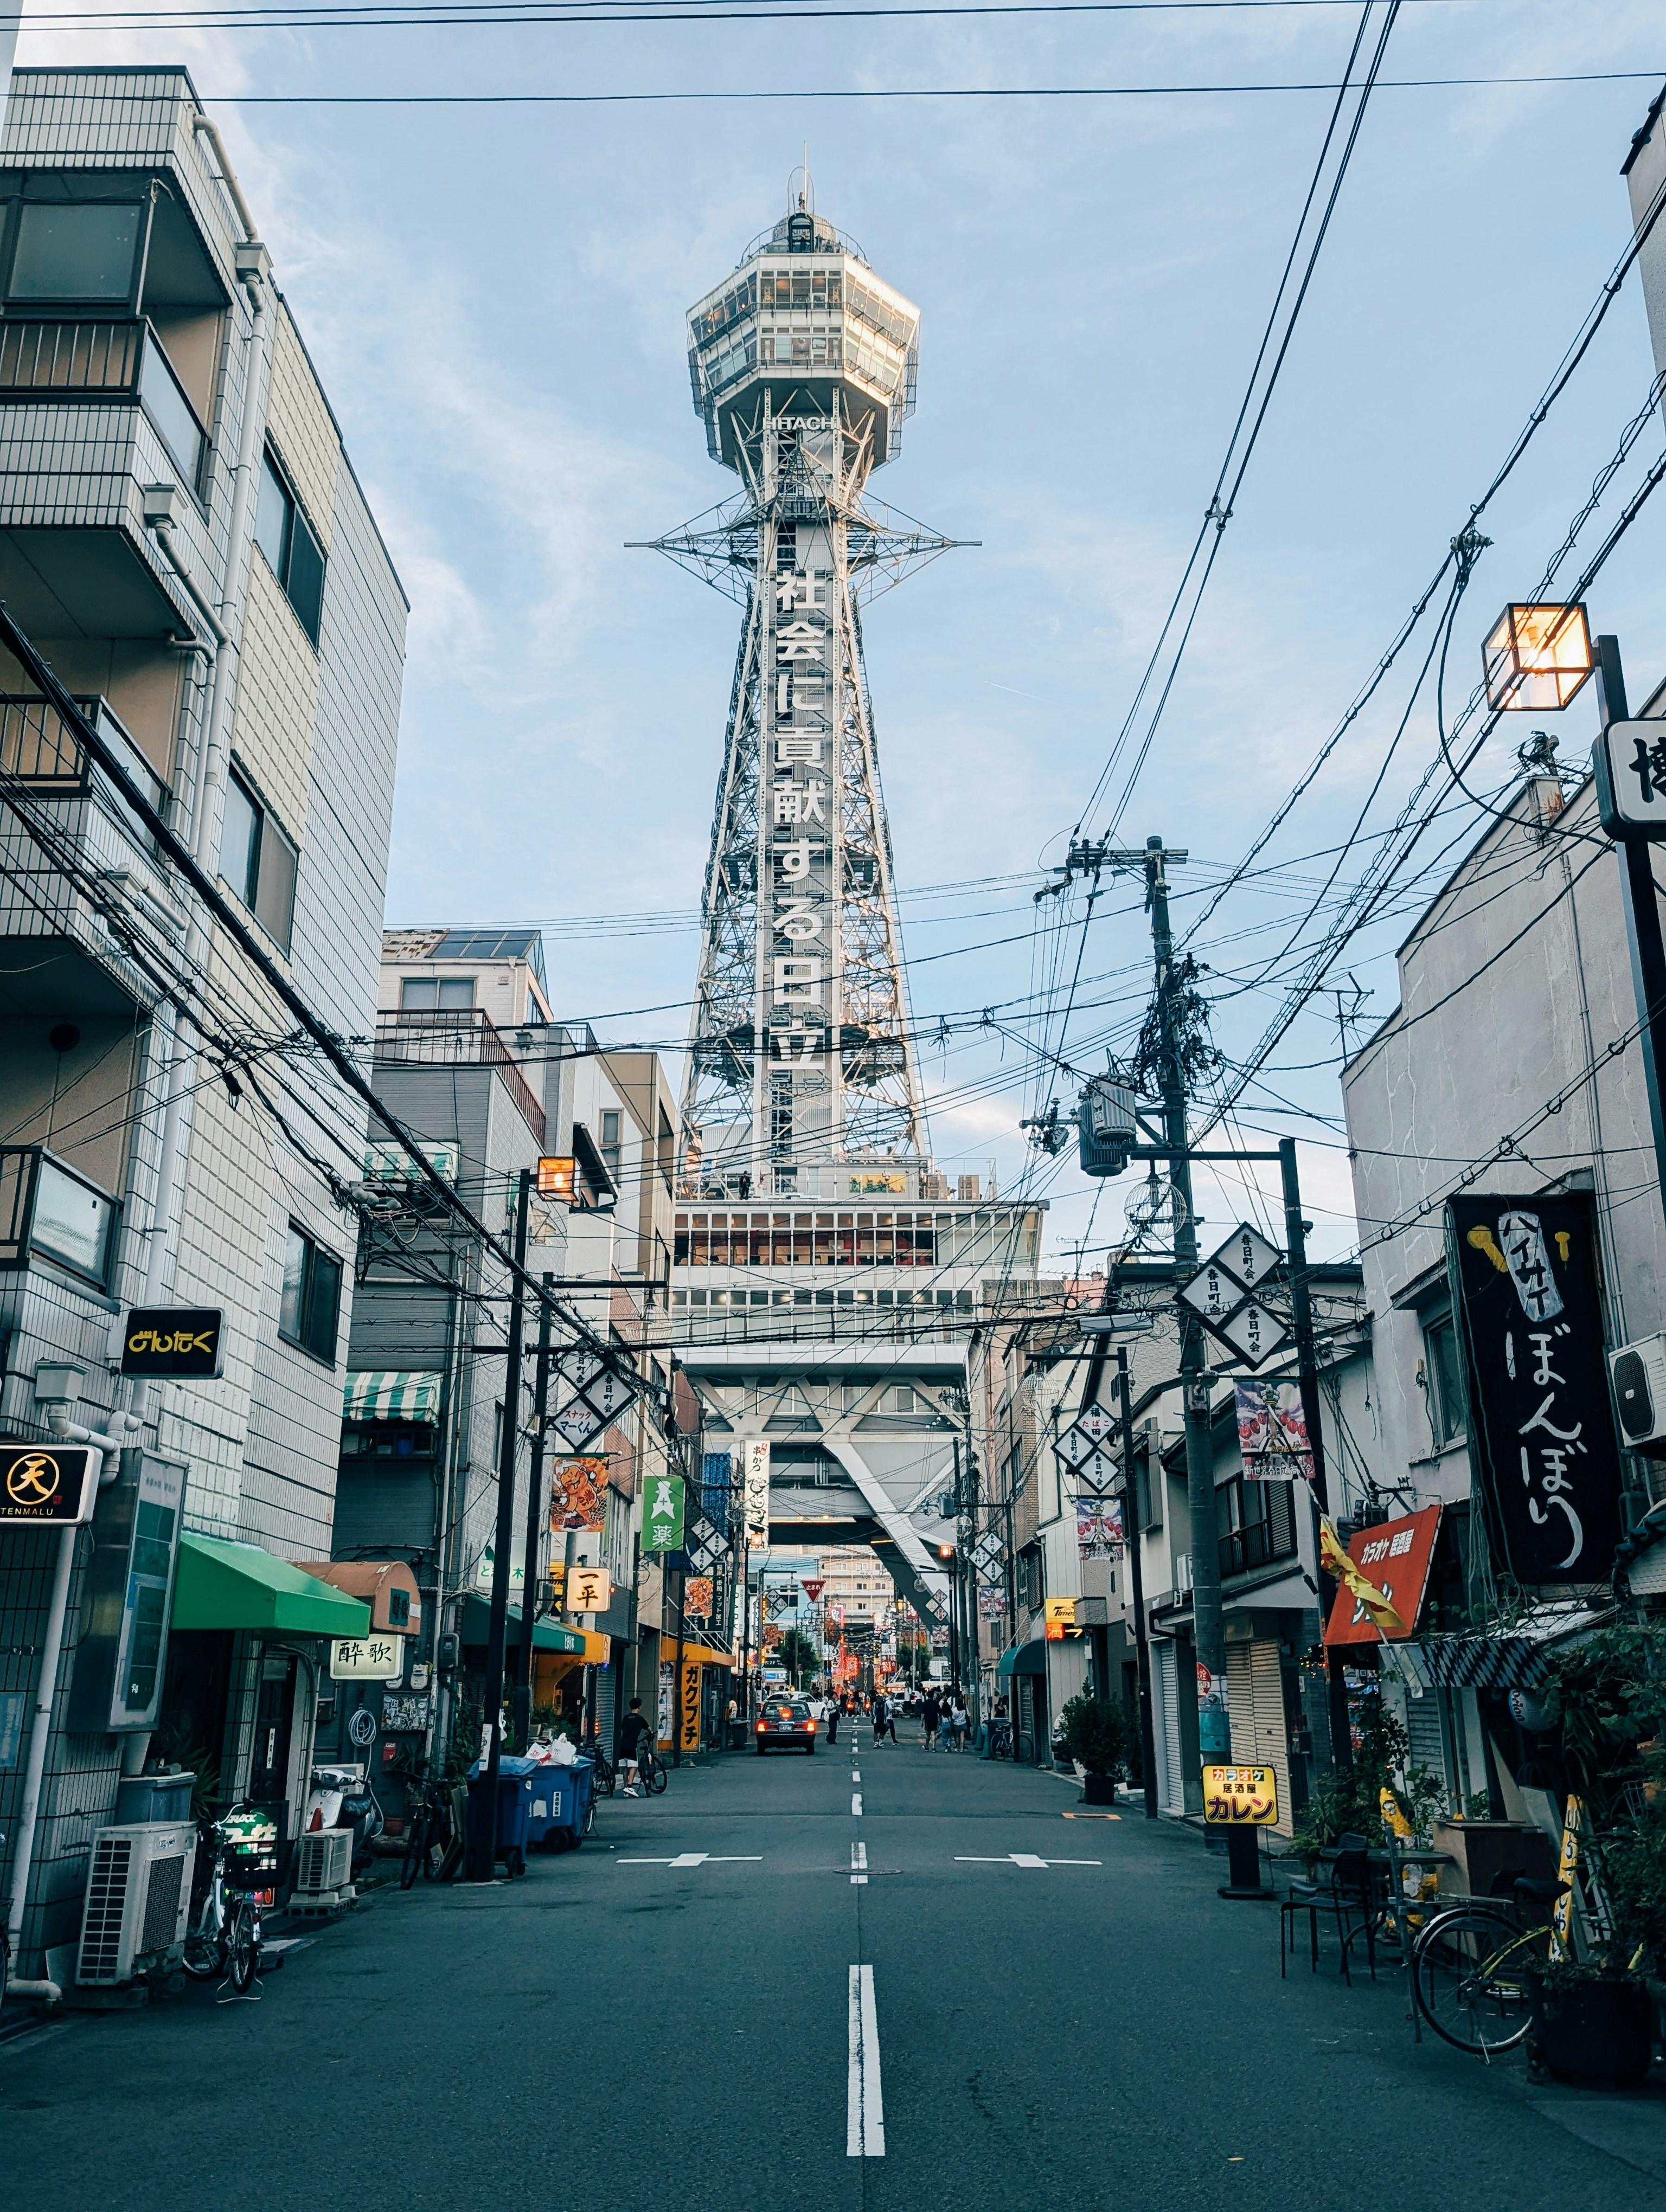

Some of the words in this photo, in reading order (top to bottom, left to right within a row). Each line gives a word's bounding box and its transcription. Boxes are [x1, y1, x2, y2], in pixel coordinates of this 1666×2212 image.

[762, 416, 841, 430] HITACHI
[767, 570, 826, 1071] 社会に貢献する日立
[1241, 1233, 1255, 1281] 春日町会
[1207, 1268, 1222, 1316] 春日町会
[129, 1330, 215, 1353] どんたく
[1247, 1308, 1261, 1353] 春日町会
[603, 1374, 614, 1413] 春日町会
[560, 1420, 594, 1435] マーくん
[565, 1410, 592, 1420] スナック
[1082, 1419, 1110, 1427] たばこ
[752, 1445, 761, 1471] 串かつ
[1070, 1431, 1079, 1461] 春日町会
[1505, 1322, 1590, 1570] ぼんぼり
[11, 1459, 50, 1495] 天
[1094, 1454, 1103, 1486] 春日町会
[652, 1525, 672, 1546] 薬
[1389, 1528, 1415, 1558] 居酒屋
[1361, 1537, 1390, 1565] カラオケ
[576, 1573, 599, 1609] 一平
[338, 1642, 392, 1667] 酔歌
[684, 1666, 699, 1745] ガクブチ
[1213, 1769, 1264, 1781] カラオケ
[1223, 1784, 1257, 1793] 居酒屋
[1207, 1795, 1274, 1821] カレン
